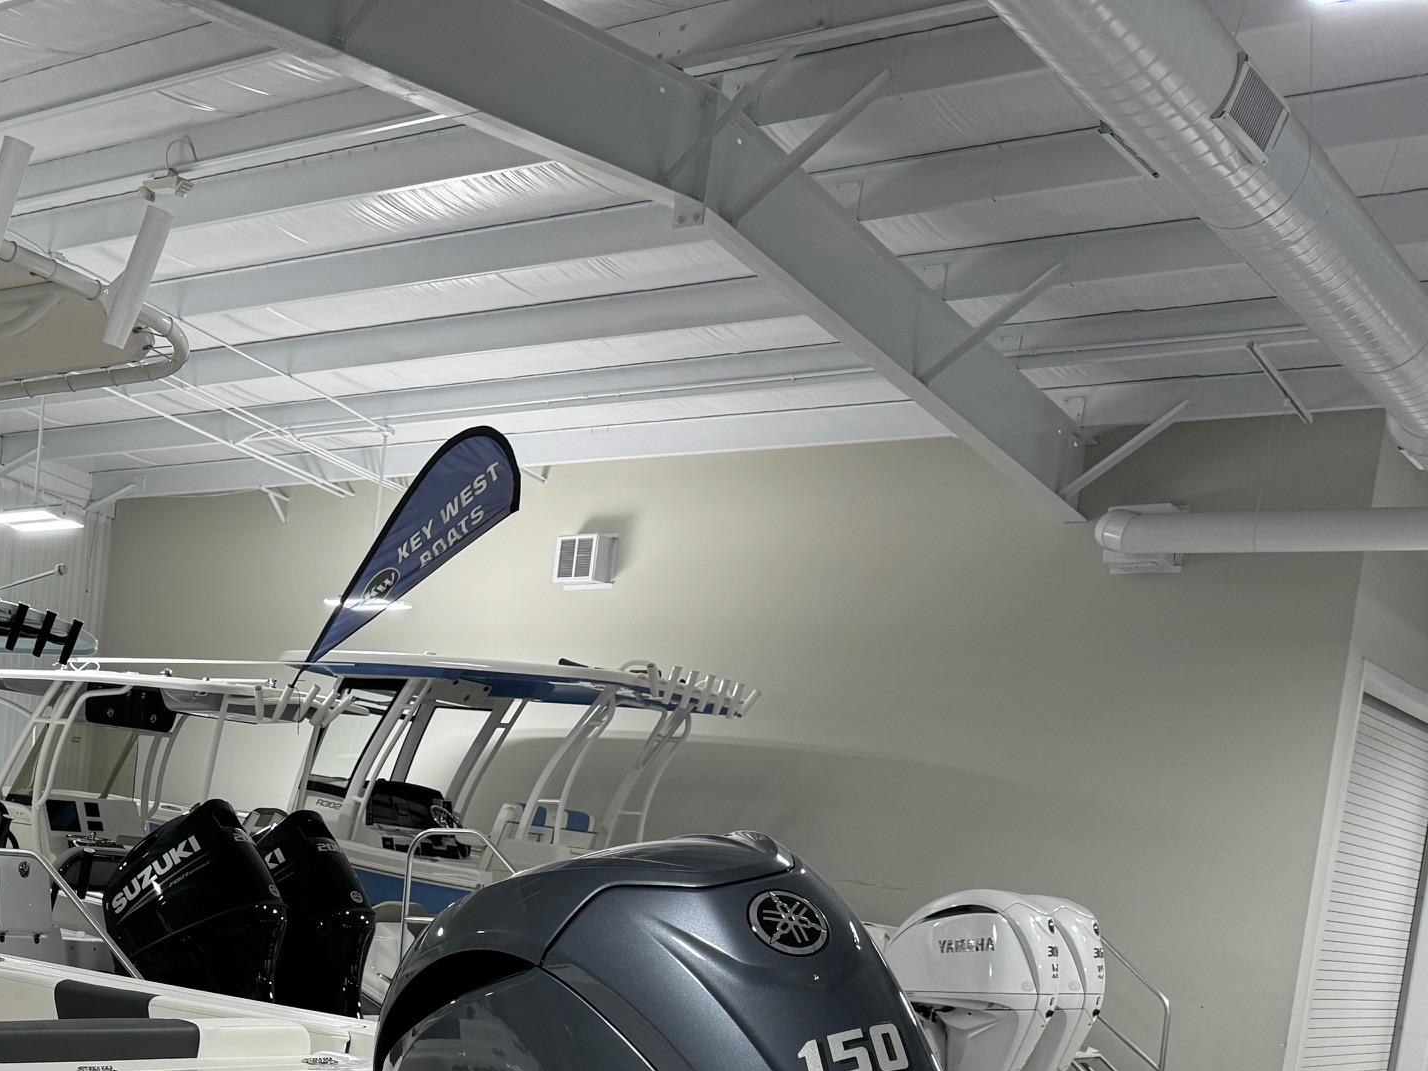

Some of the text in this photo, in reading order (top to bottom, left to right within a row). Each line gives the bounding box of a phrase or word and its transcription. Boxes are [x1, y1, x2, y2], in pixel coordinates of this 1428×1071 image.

[397, 461, 501, 564] KEY WEST
[419, 505, 486, 569] BOATS
[111, 835, 202, 914] SUZUKI
[939, 937, 995, 954] YAMAHA
